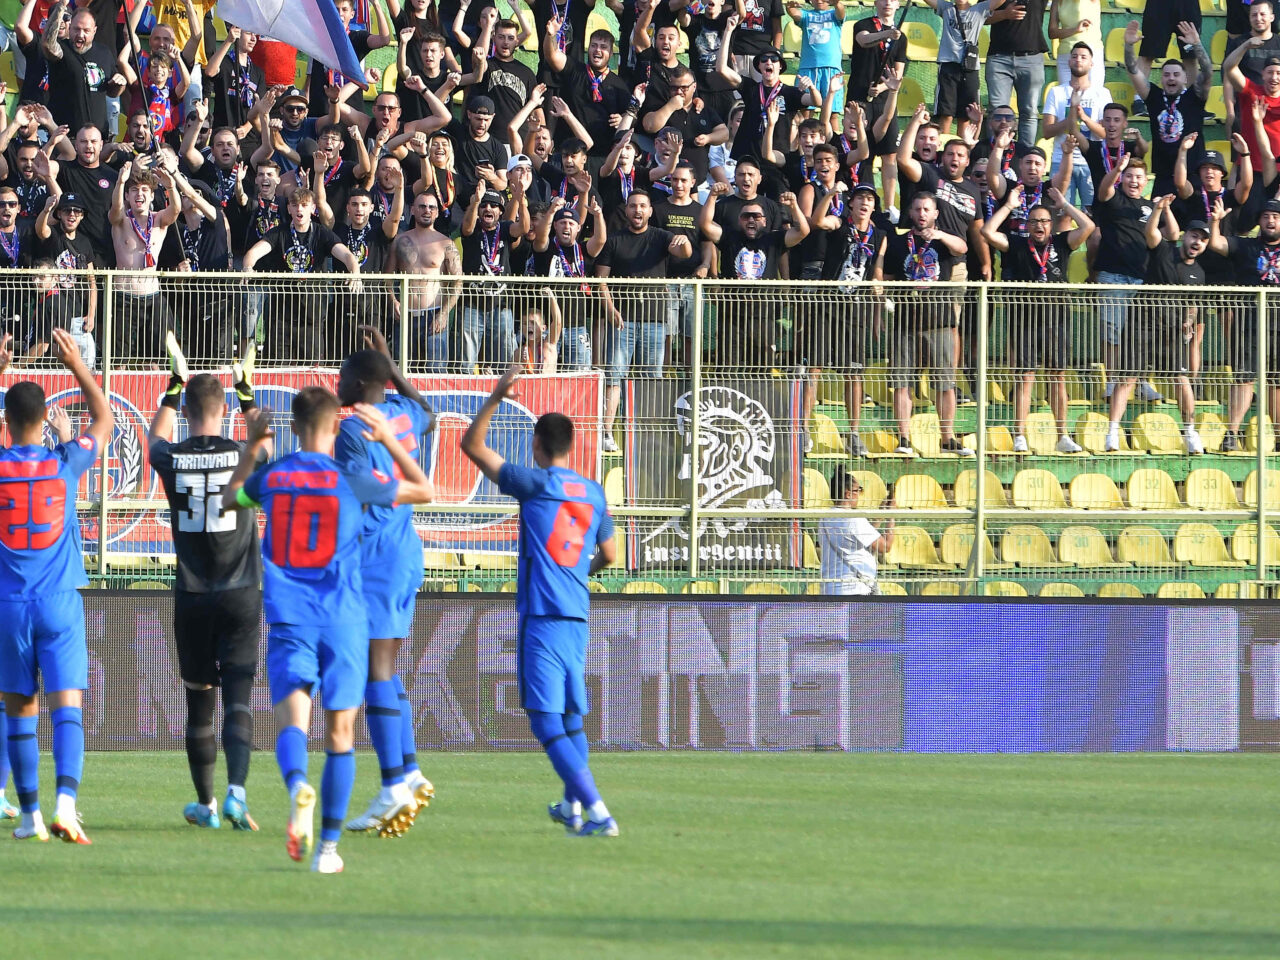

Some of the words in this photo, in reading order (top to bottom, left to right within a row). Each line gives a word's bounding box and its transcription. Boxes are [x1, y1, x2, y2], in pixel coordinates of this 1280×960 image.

[809, 12, 833, 22] TEAM
[172, 452, 239, 470] TARNOVANU
[175, 470, 238, 533] 32
[272, 494, 339, 569] 10
[546, 500, 594, 568] 8
